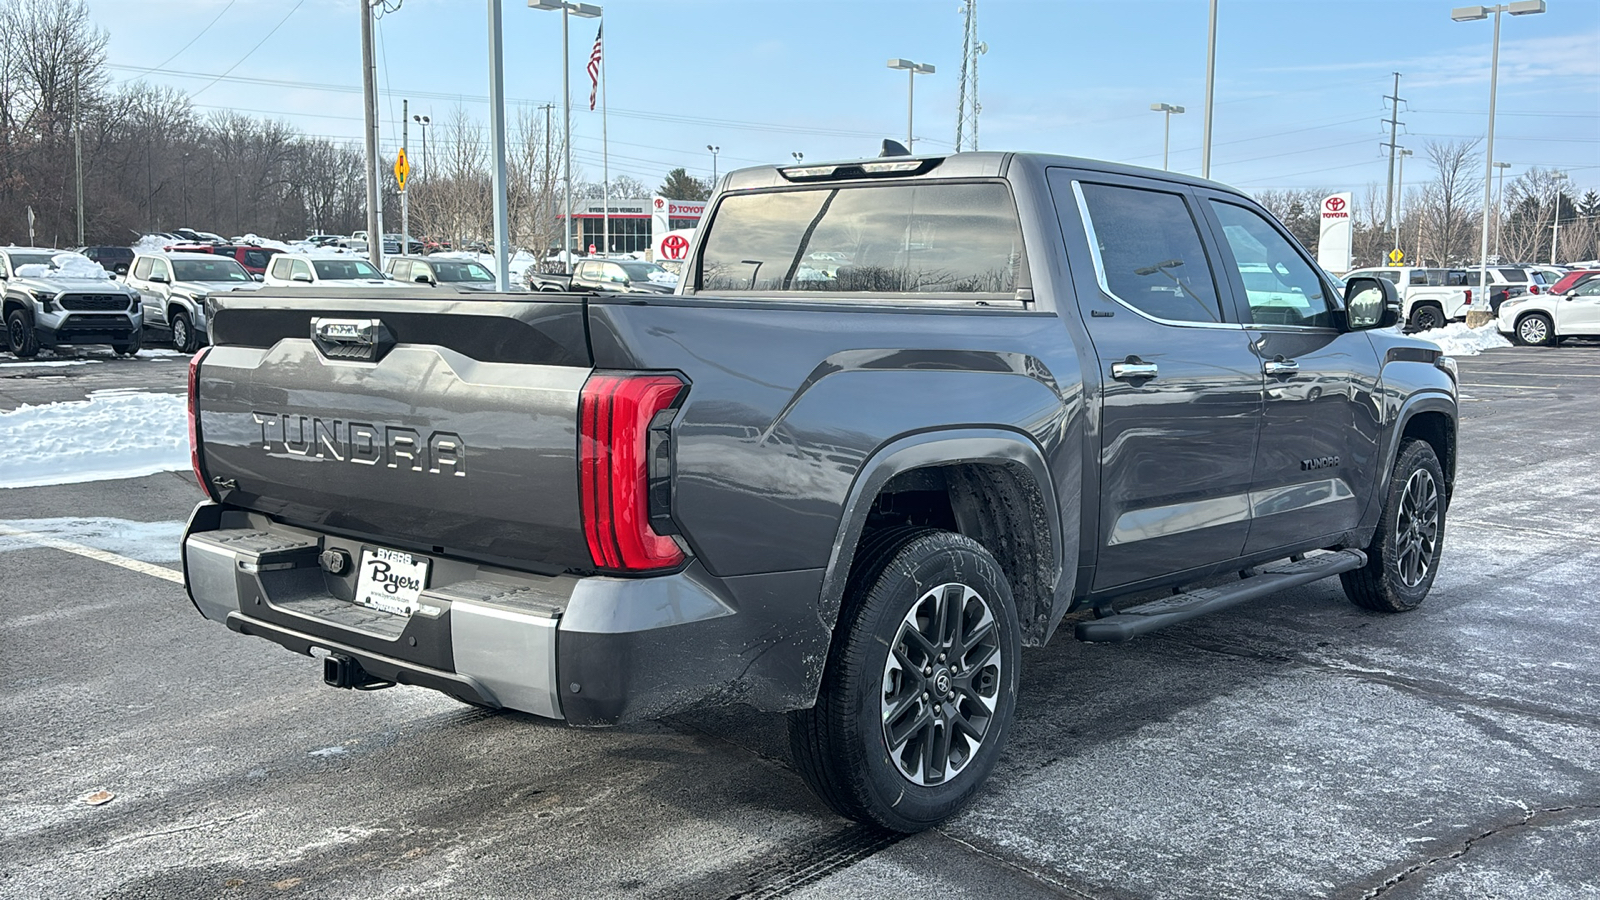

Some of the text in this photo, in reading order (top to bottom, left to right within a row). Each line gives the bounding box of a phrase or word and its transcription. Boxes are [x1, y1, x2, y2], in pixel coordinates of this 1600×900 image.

[678, 205, 704, 213] TOYOT
[252, 410, 466, 477] TUNDRA
[1300, 455, 1340, 471] TUNDRA
[377, 547, 412, 566] BYERS
[367, 559, 420, 594] Byers
